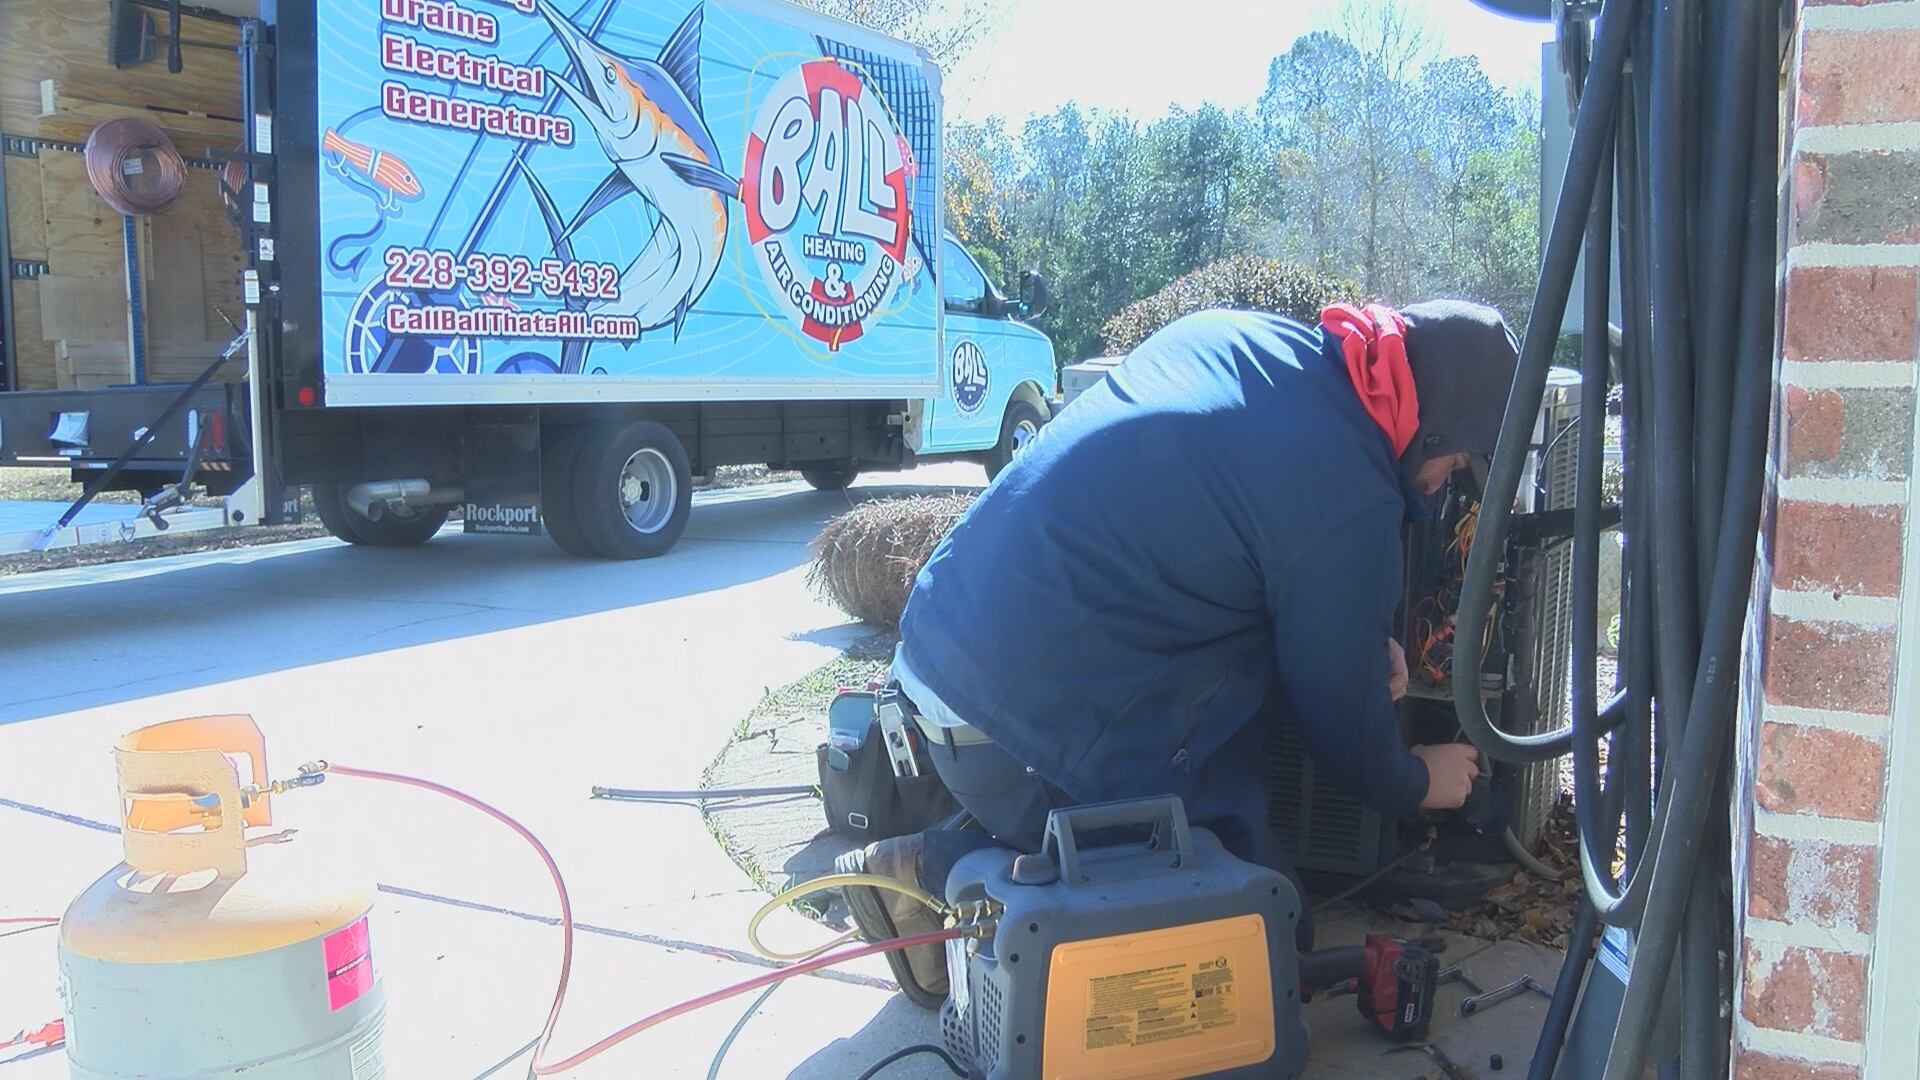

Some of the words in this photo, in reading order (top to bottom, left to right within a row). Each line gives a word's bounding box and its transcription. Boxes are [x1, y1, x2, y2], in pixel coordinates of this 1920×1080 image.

[384, 0, 495, 40] Drains
[384, 36, 543, 95] Electrical
[385, 84, 571, 142] Generators
[759, 86, 898, 244] BALL
[804, 236, 865, 262] HEATING
[385, 251, 618, 297] 228-392-5432
[766, 241, 792, 288] AIR
[790, 255, 895, 326] CONDITIONING
[824, 263, 847, 298] &
[388, 307, 638, 337] CallBallThatsAll.com
[466, 503, 537, 525] Rockport
